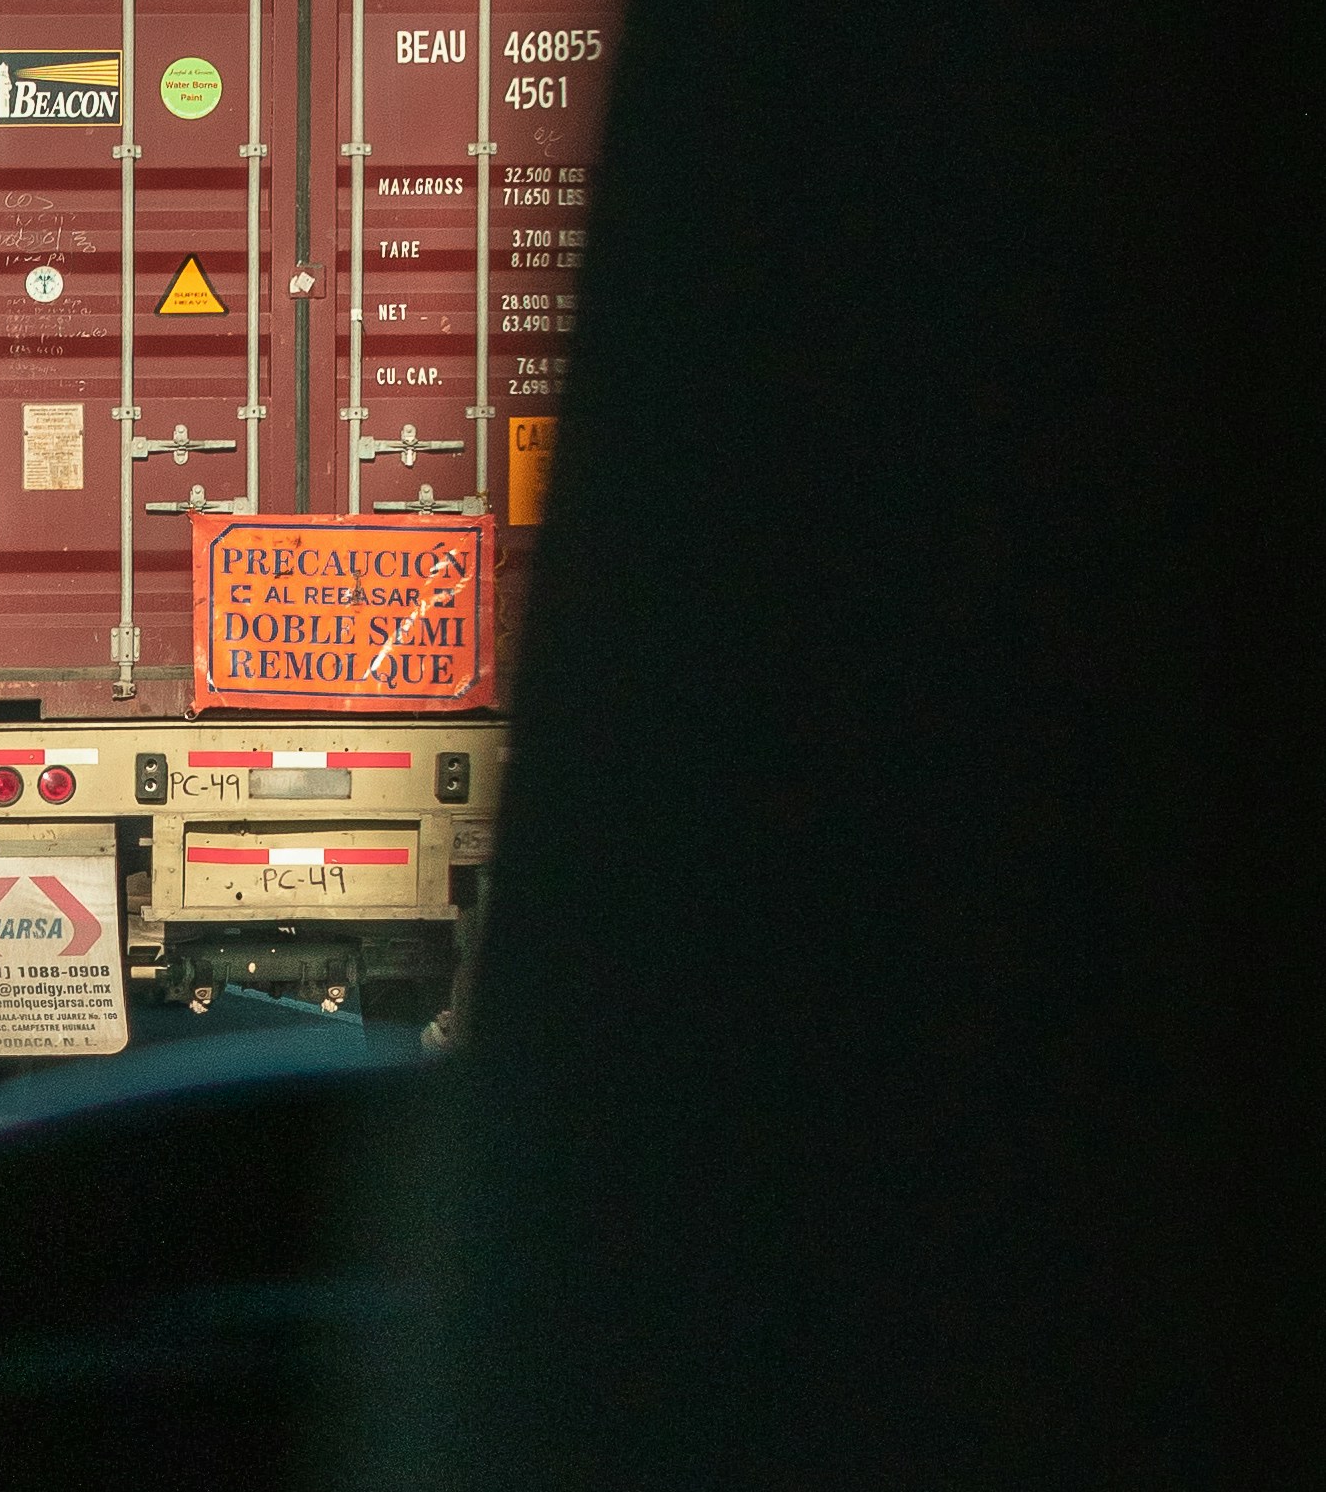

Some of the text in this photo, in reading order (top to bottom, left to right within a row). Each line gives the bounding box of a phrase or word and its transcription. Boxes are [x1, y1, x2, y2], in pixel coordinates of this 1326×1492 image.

[396, 29, 602, 64] BEAU 468855
[166, 81, 218, 89] Water Borne
[504, 76, 569, 110] 45G1
[10, 81, 119, 119] BEACON
[181, 94, 203, 102] Paint
[504, 167, 585, 183] 32.500 KGS
[378, 177, 464, 196] MAX.GROSS
[503, 188, 584, 206] 71.650 LBS
[512, 230, 551, 247] 3.700
[380, 240, 420, 259] TARE
[511, 252, 550, 268] 8.160
[501, 294, 549, 310] 28.800
[378, 303, 408, 321] NET
[502, 315, 550, 332] 63.490
[516, 358, 549, 375] 76.4
[508, 379, 550, 395] 2.698
[220, 541, 470, 580] PRECAUCIÓN
[264, 586, 421, 607] AL REBASAR
[224, 611, 466, 648] DOBLE SEMI
[228, 648, 455, 690] REMOLQUE
[169, 772, 240, 802] PC-49
[262, 866, 347, 895] PC-49
[17, 965, 111, 979] 1088-0908
[11, 1023, 61, 1032] CAMPESTRE
